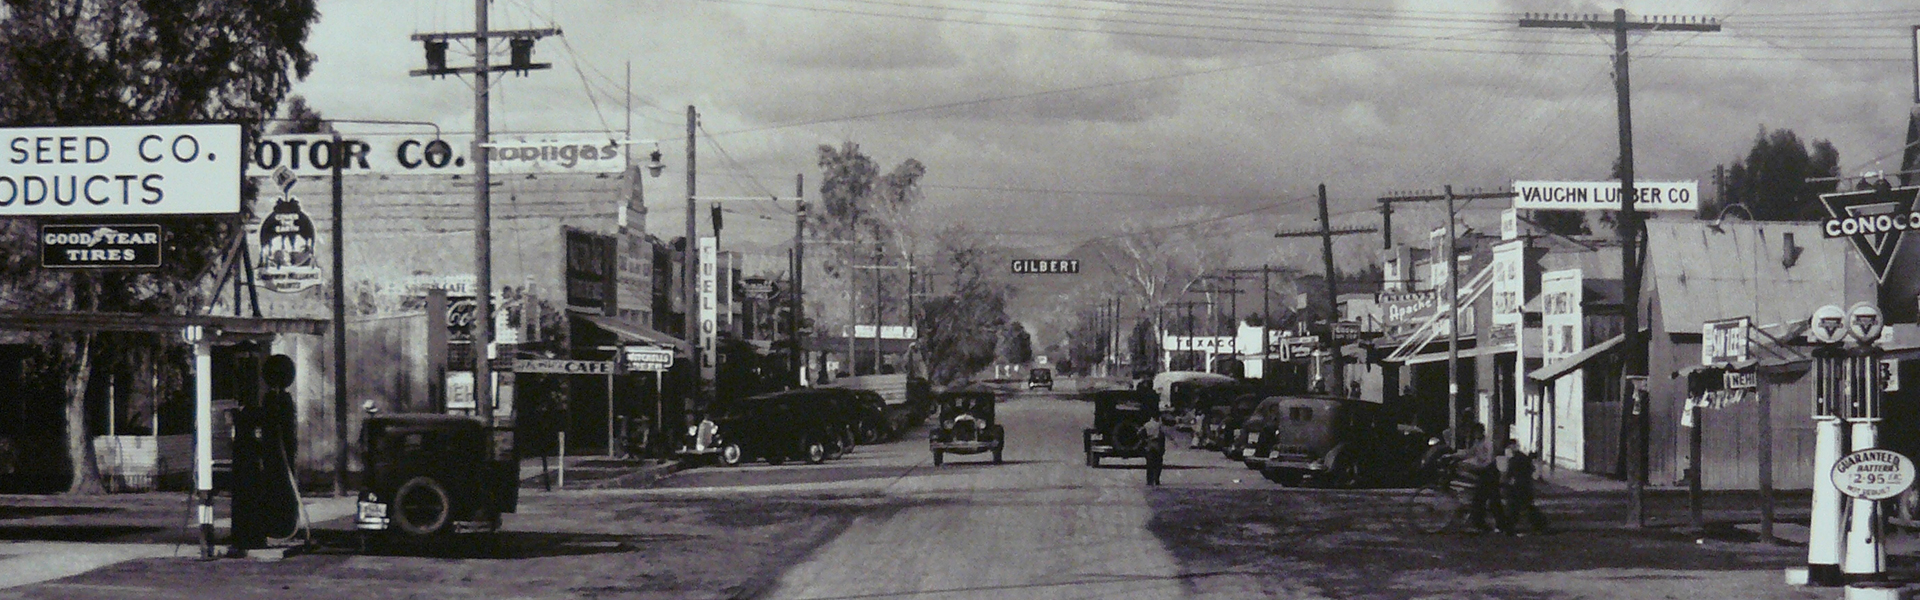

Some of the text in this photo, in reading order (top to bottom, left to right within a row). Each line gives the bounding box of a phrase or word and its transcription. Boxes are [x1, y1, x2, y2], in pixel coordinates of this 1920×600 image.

[10, 133, 217, 164] SEED CO.
[396, 138, 466, 170] CO.
[1521, 186, 1588, 204] VAUGHN
[1825, 211, 1920, 237] CONOCO
[66, 249, 136, 263] TIRES
[1012, 260, 1079, 273] GILBERT
[702, 318, 714, 369] OIL
[1176, 338, 1236, 349] TEXACO
[564, 361, 609, 374] CAFE
[1837, 451, 1901, 474] GUARANTEED
